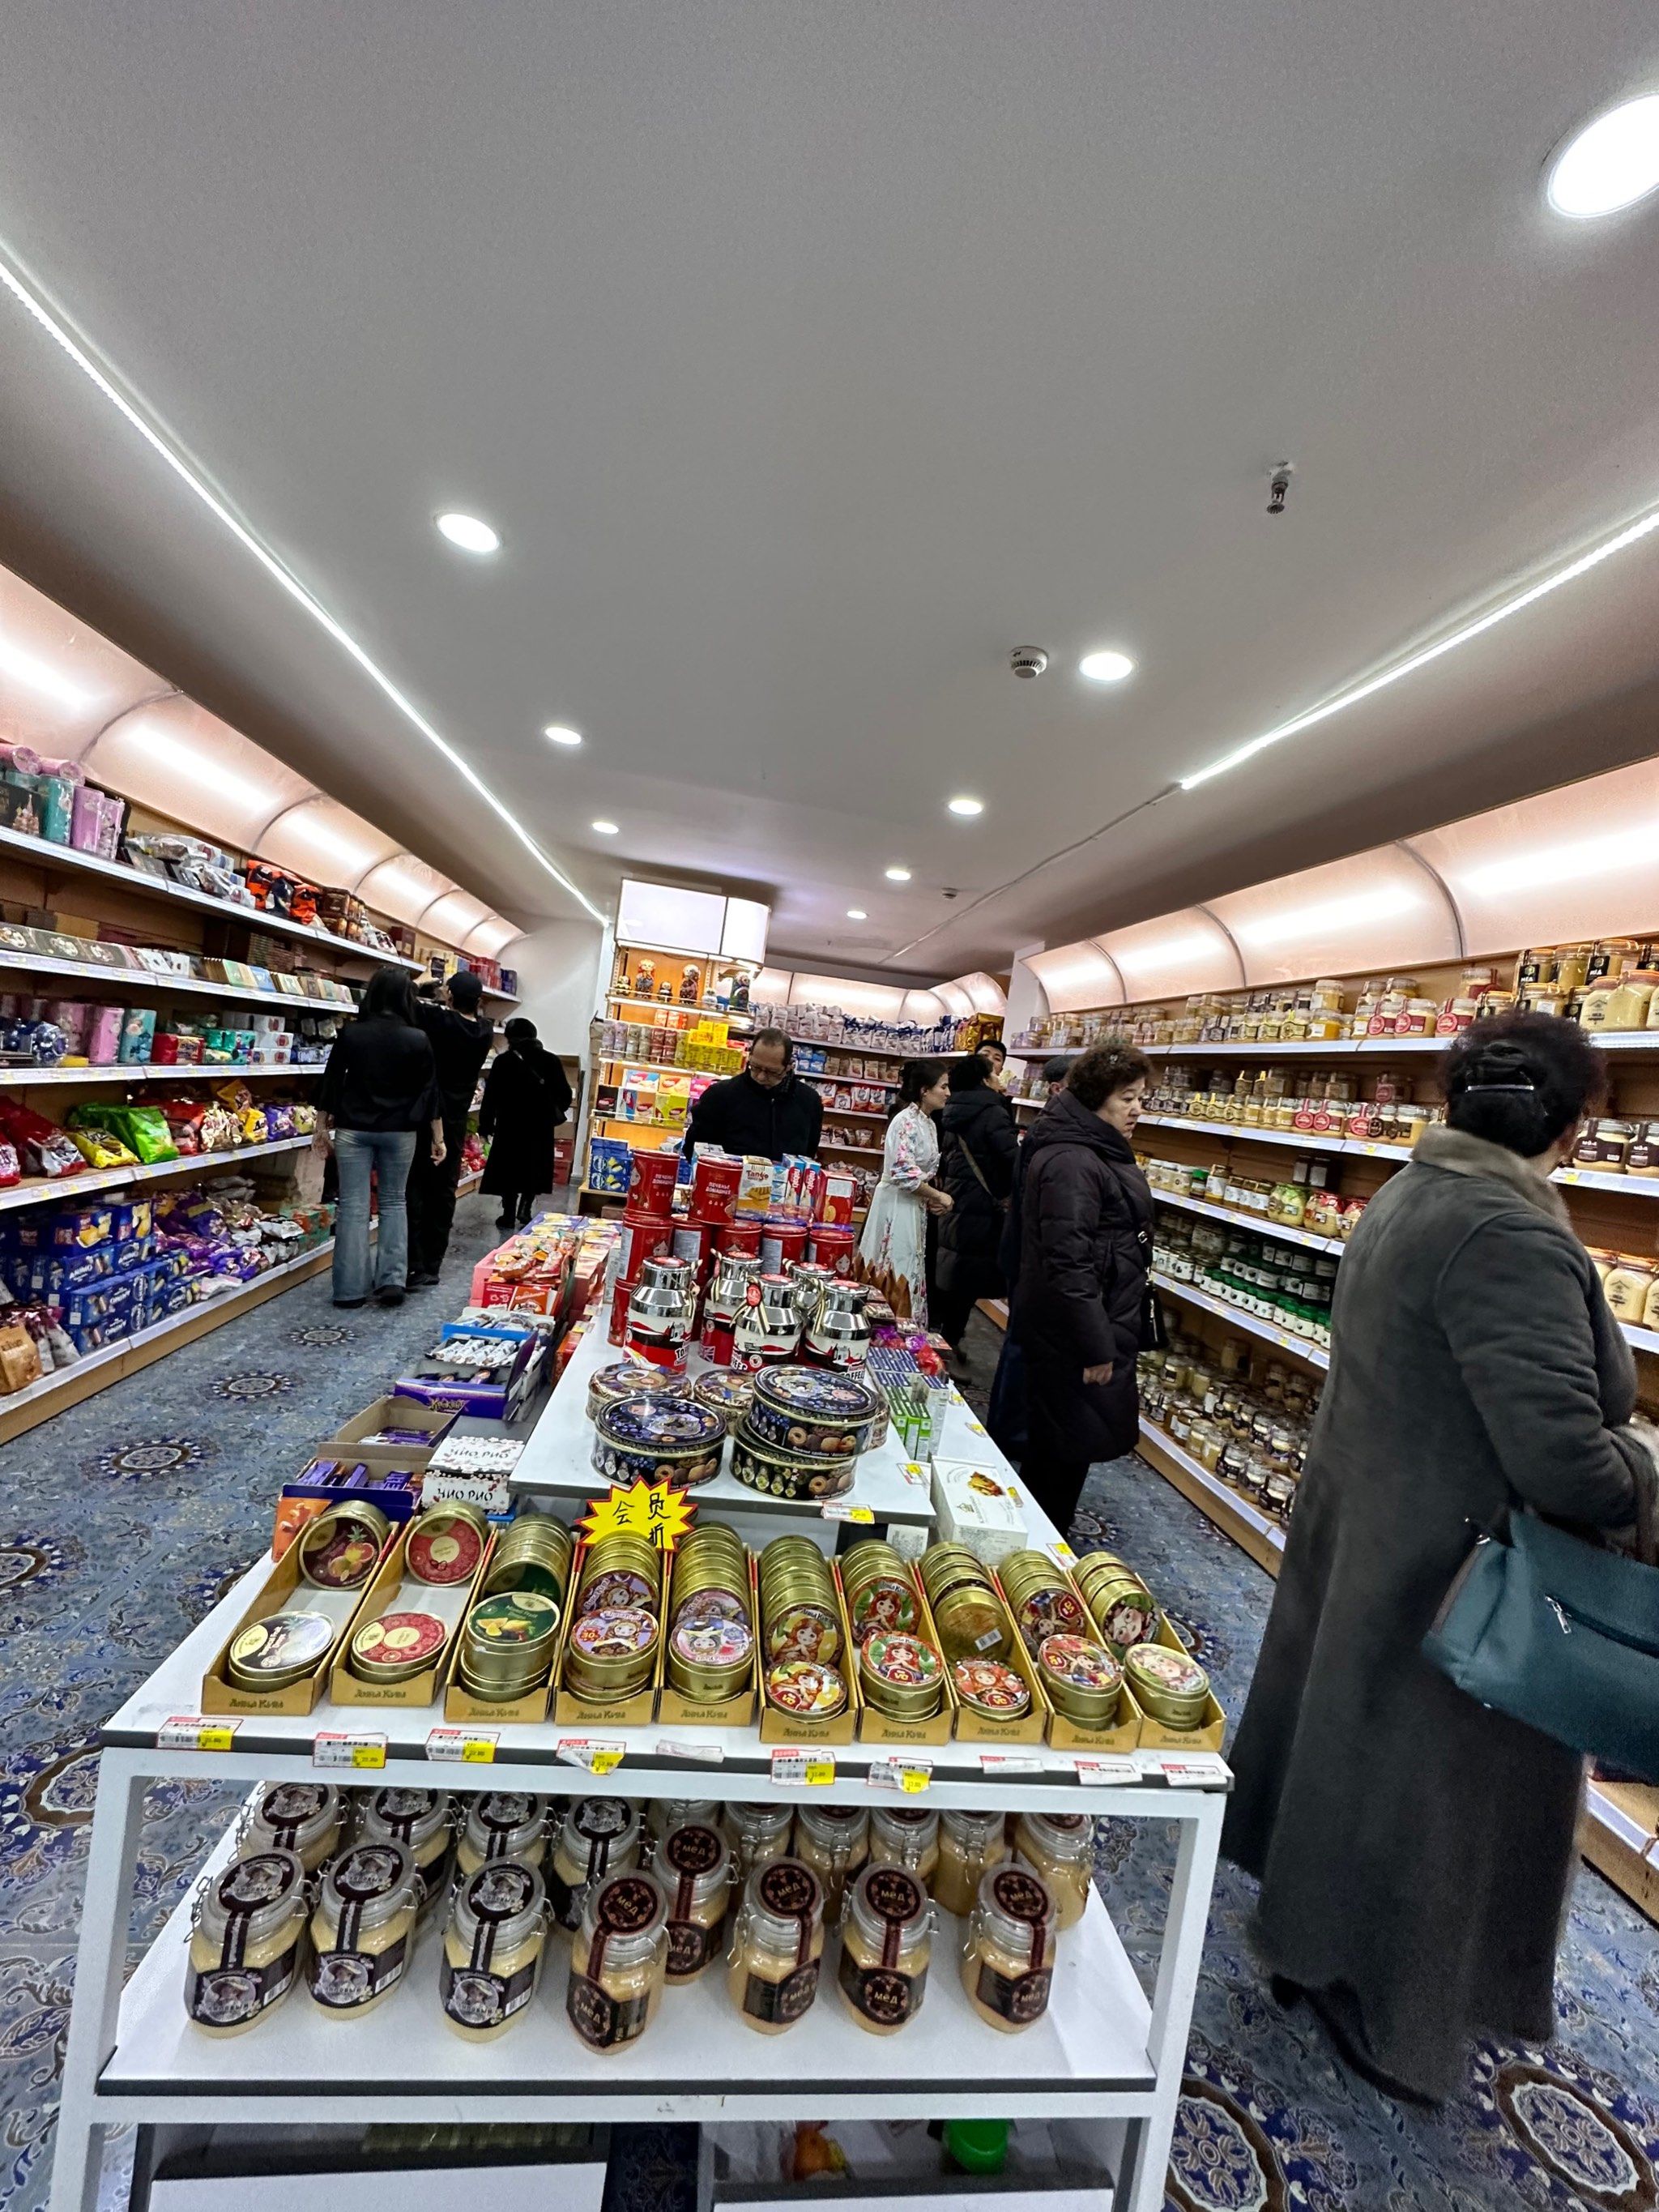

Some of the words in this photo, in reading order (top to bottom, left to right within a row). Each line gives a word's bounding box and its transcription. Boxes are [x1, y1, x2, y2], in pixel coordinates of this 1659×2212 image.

[746, 1169, 769, 1181] Tango
[482, 1450, 510, 1460] РИО
[437, 1488, 464, 1499] ЧИО
[468, 1490, 493, 1501] РИО
